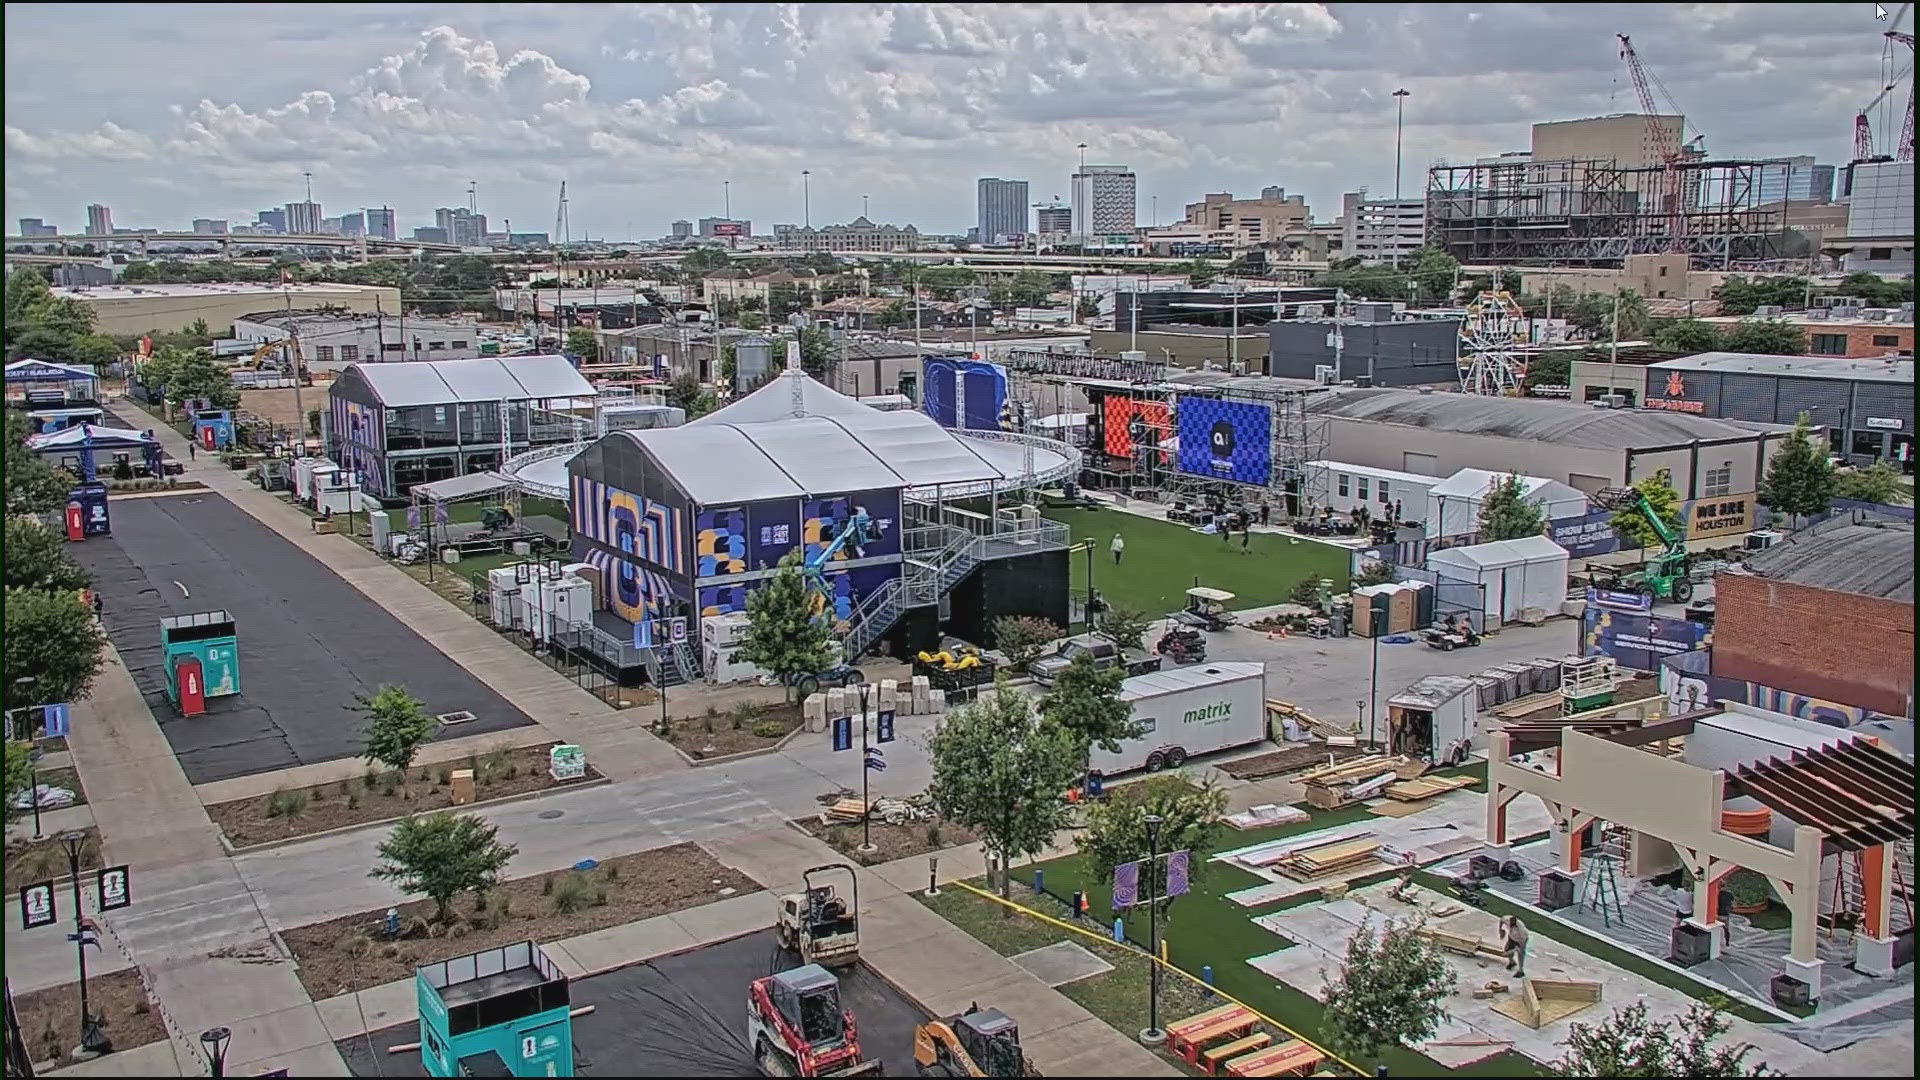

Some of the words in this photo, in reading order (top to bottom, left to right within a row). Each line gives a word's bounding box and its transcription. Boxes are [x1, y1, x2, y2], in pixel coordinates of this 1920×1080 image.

[1697, 503, 1716, 518] WE
[1719, 500, 1745, 516] ARE
[1695, 516, 1745, 533] HOUSTON
[1651, 637, 1689, 650] SERVICES
[1183, 700, 1232, 724] matrix
